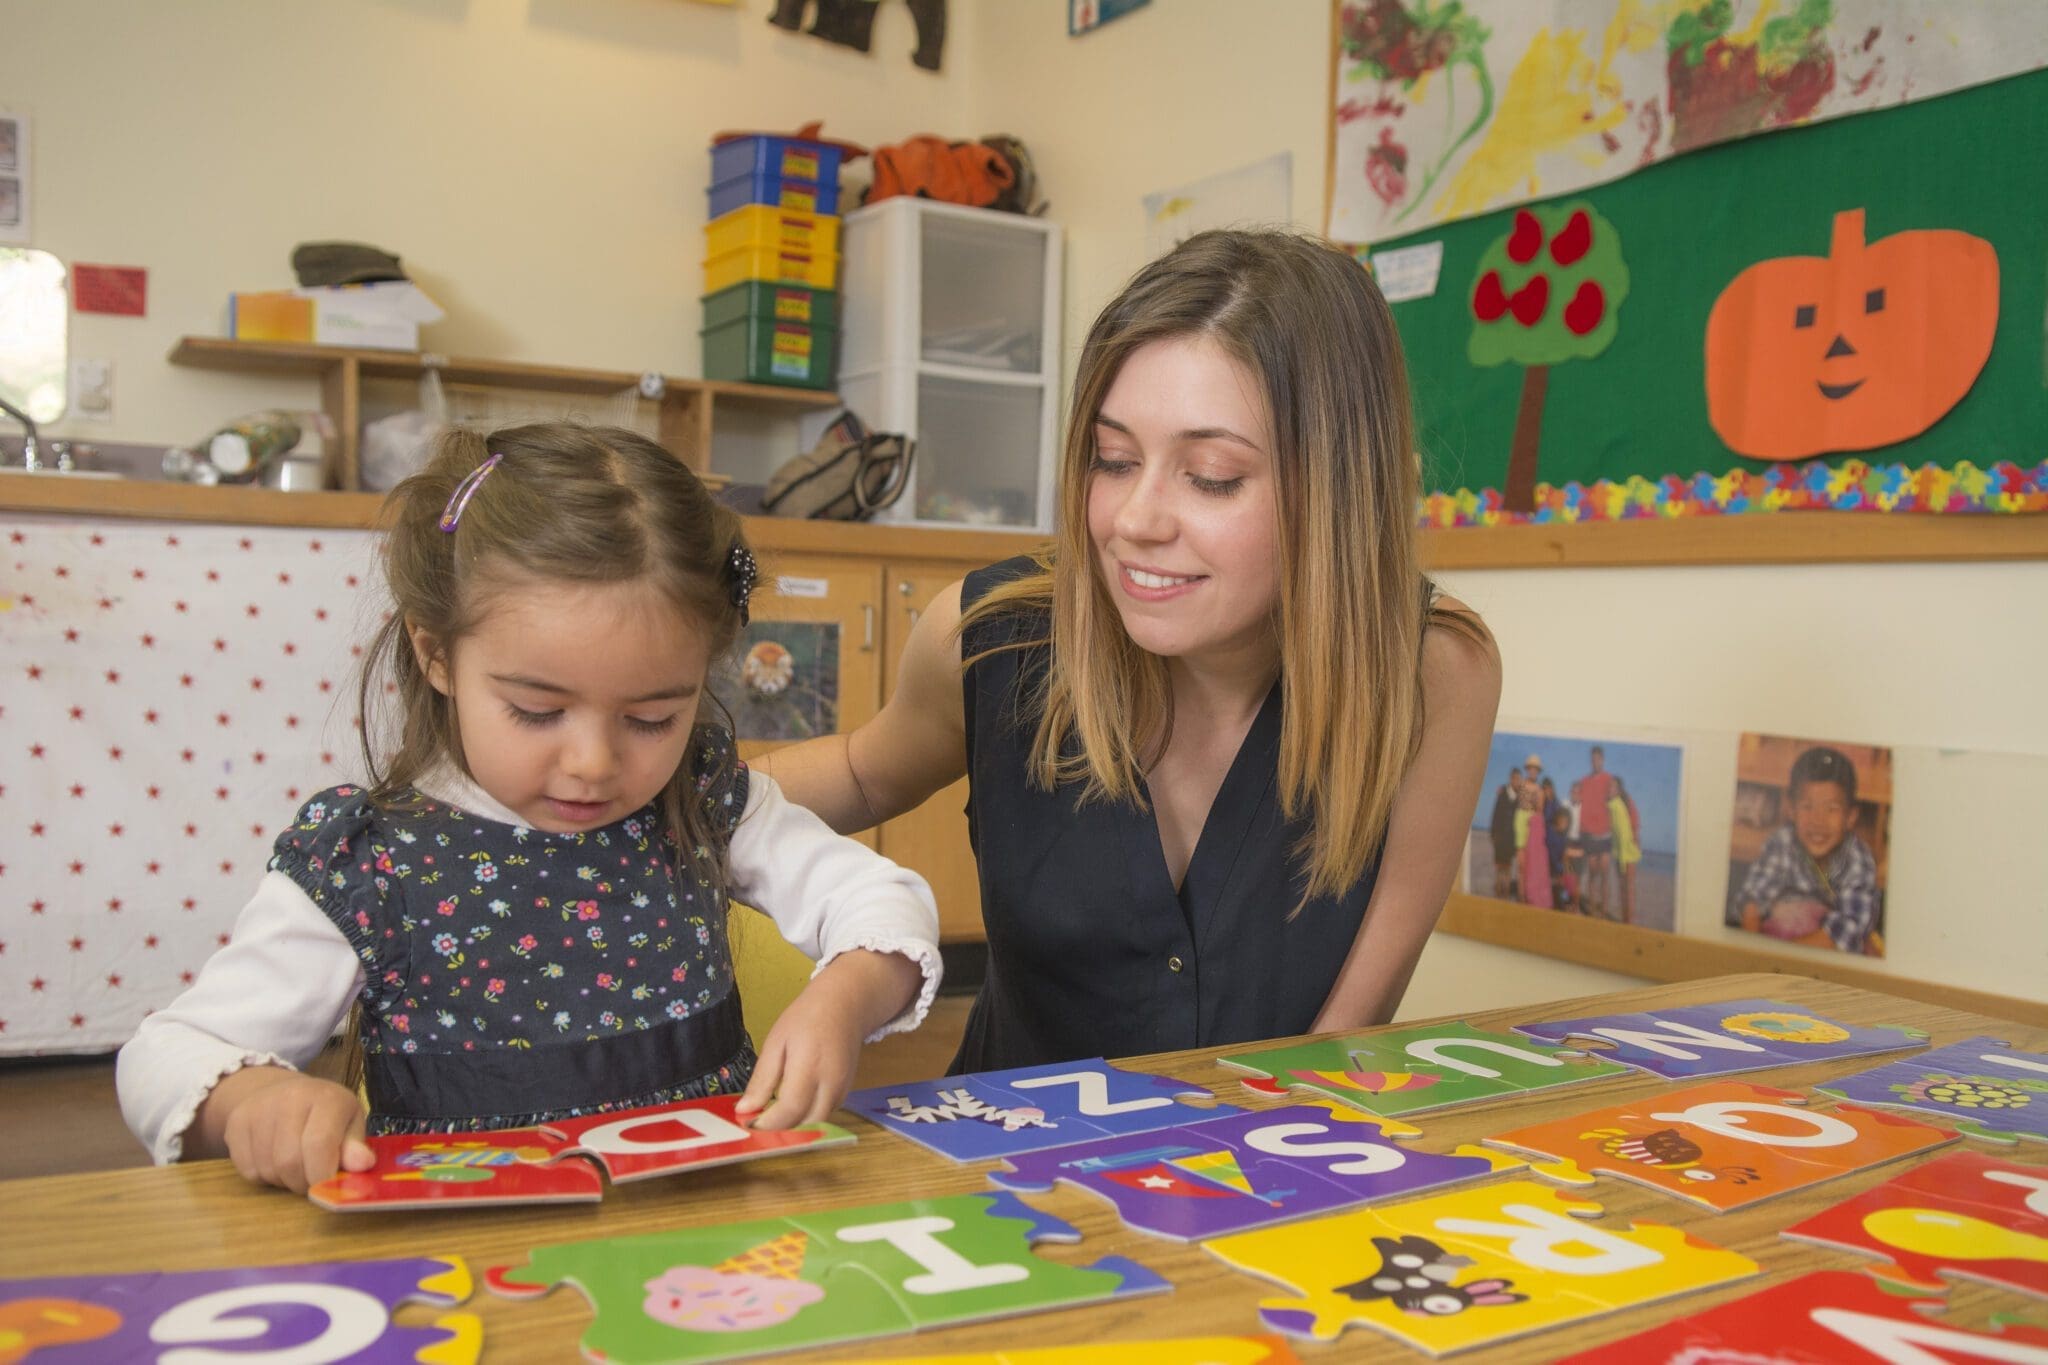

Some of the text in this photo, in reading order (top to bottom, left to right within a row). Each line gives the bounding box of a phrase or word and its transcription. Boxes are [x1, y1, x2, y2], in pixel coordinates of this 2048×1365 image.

[1405, 1038, 1565, 1078] U
[1591, 1021, 1766, 1061] N
[1010, 1071, 1174, 1116] Z
[577, 1109, 750, 1155] D
[1650, 1102, 1858, 1147] Q
[1243, 1122, 1406, 1175] S
[835, 1216, 1030, 1295] I
[1435, 1204, 1664, 1274] R
[148, 1282, 389, 1365] G
